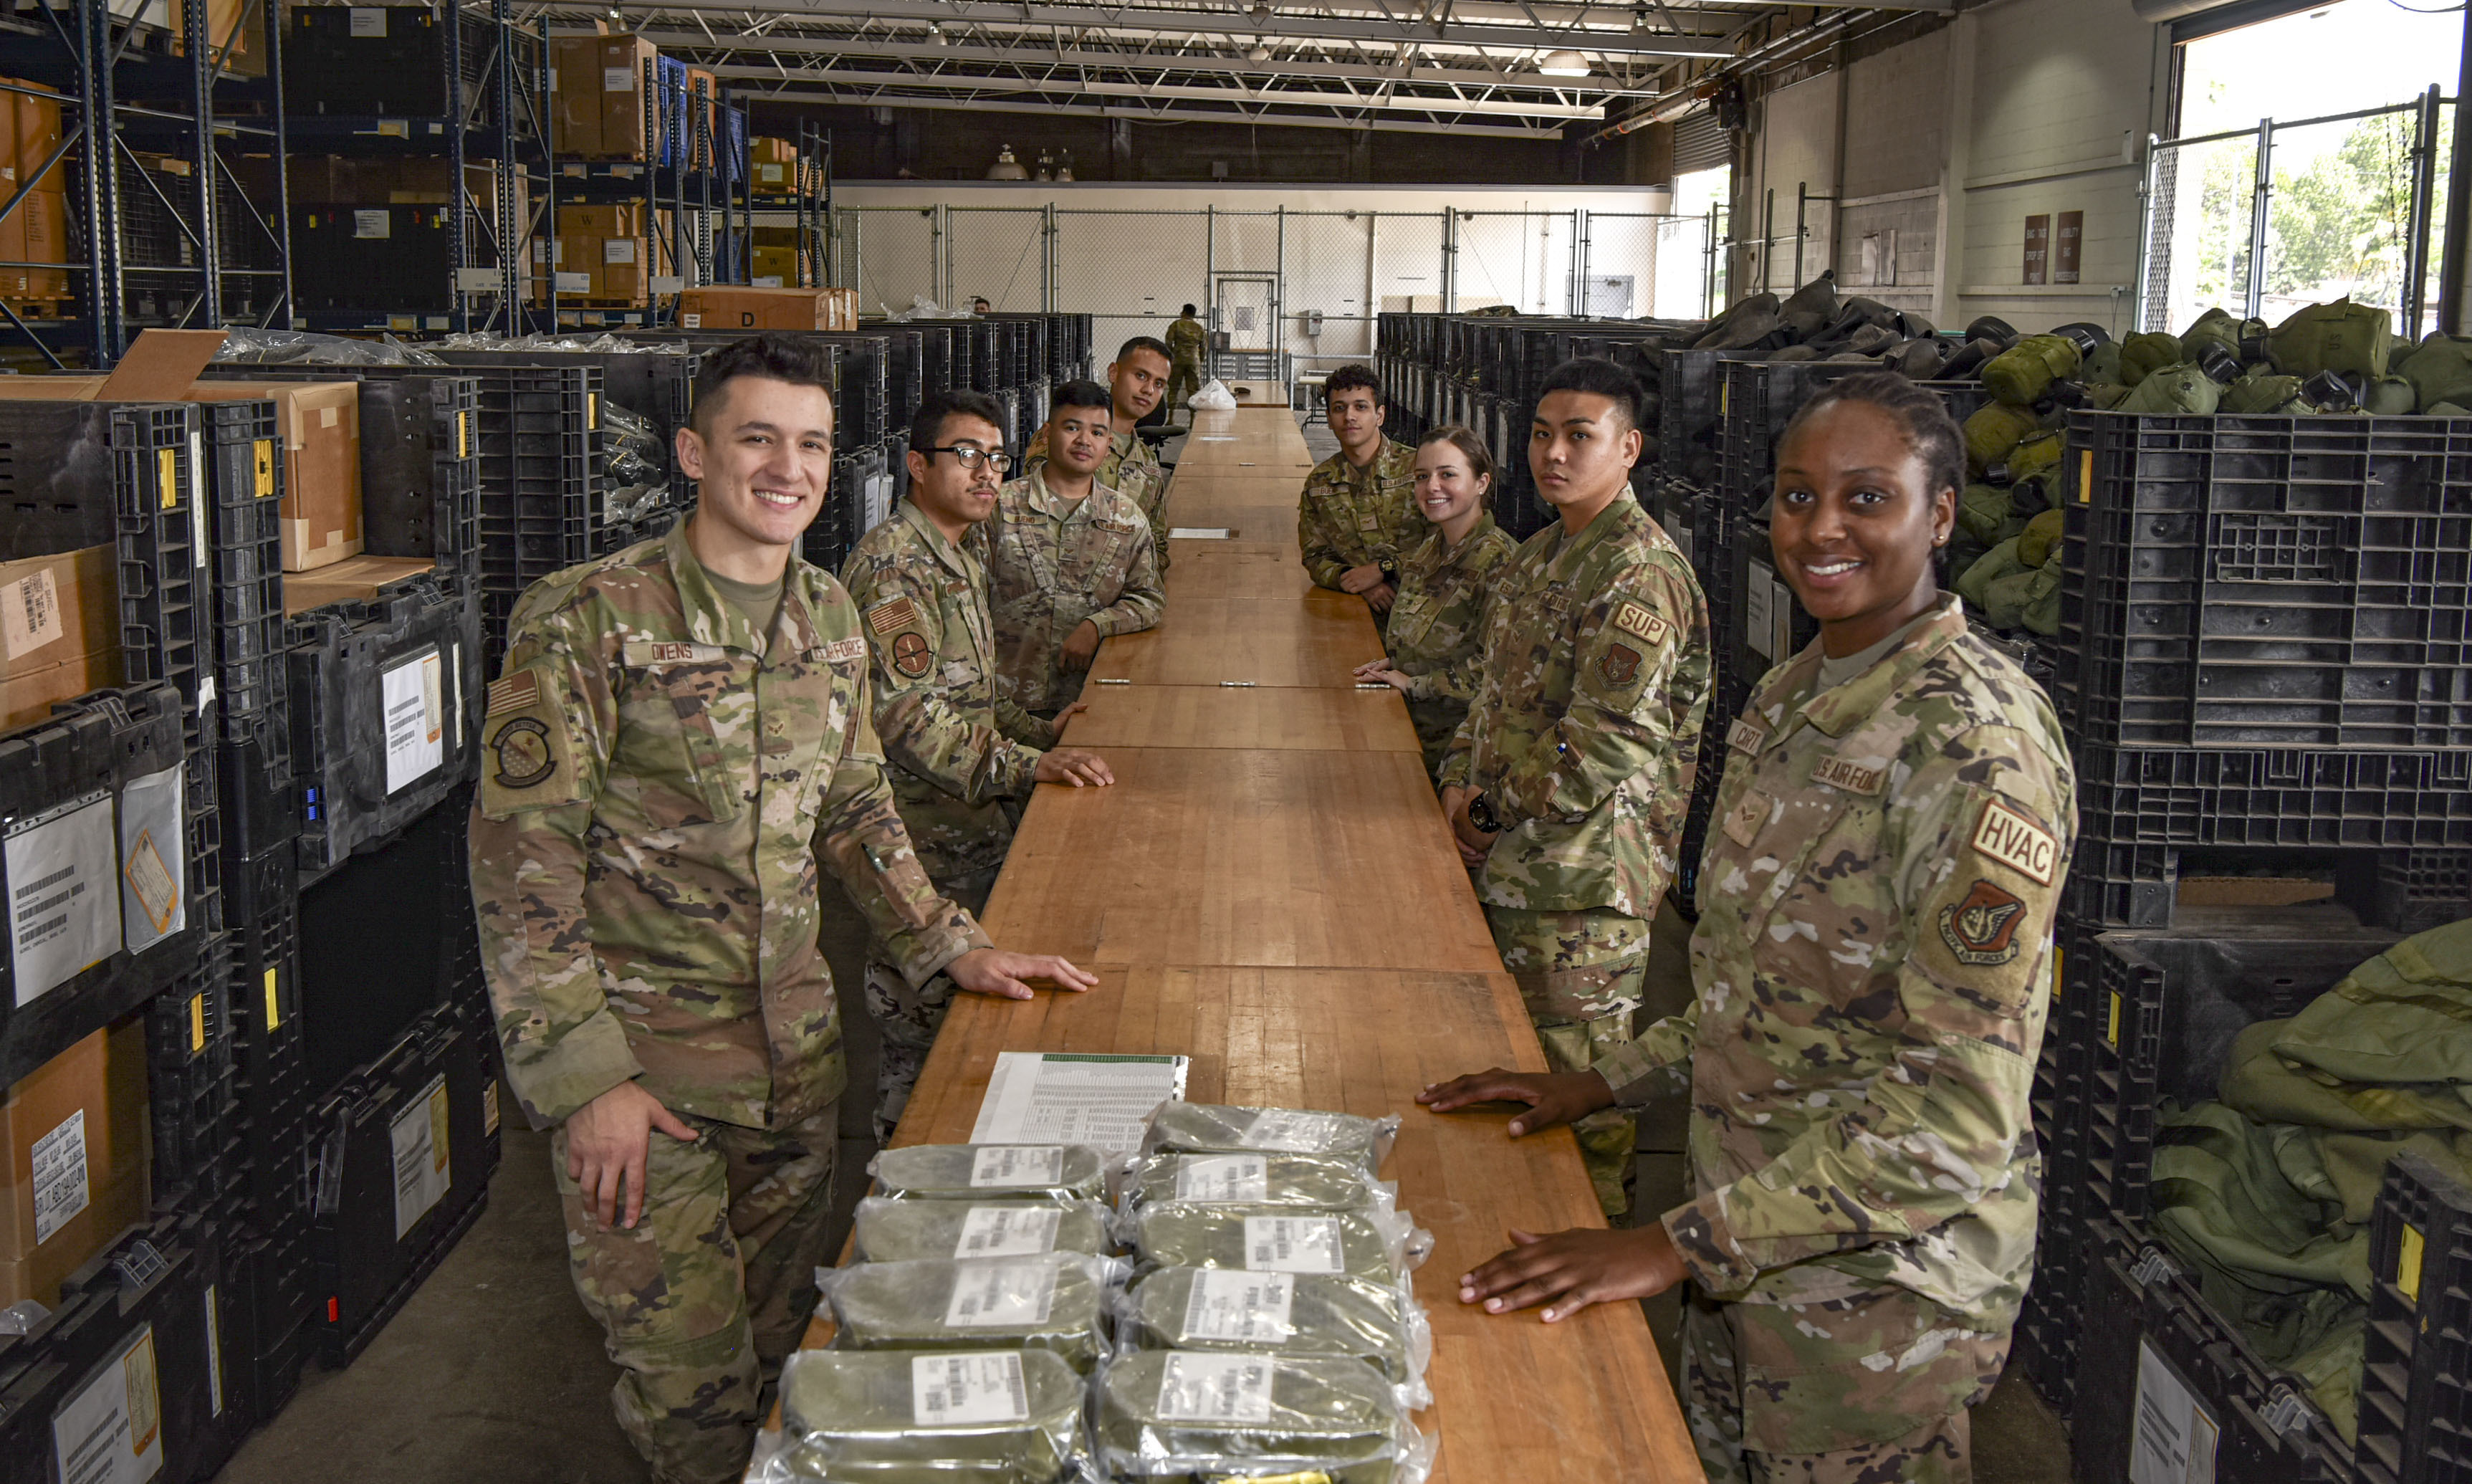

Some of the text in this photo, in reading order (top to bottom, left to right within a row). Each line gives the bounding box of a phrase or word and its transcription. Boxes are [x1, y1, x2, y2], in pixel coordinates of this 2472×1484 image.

[582, 216, 593, 225] W
[742, 312, 755, 327] D
[2329, 332, 2342, 350] US
[1015, 515, 1035, 525] BUENO
[1117, 524, 1136, 533] FORCE
[1620, 607, 1662, 636] SUP
[651, 643, 694, 659] OWENS
[833, 638, 863, 659] FORCE
[1981, 811, 2050, 873] HVAC
